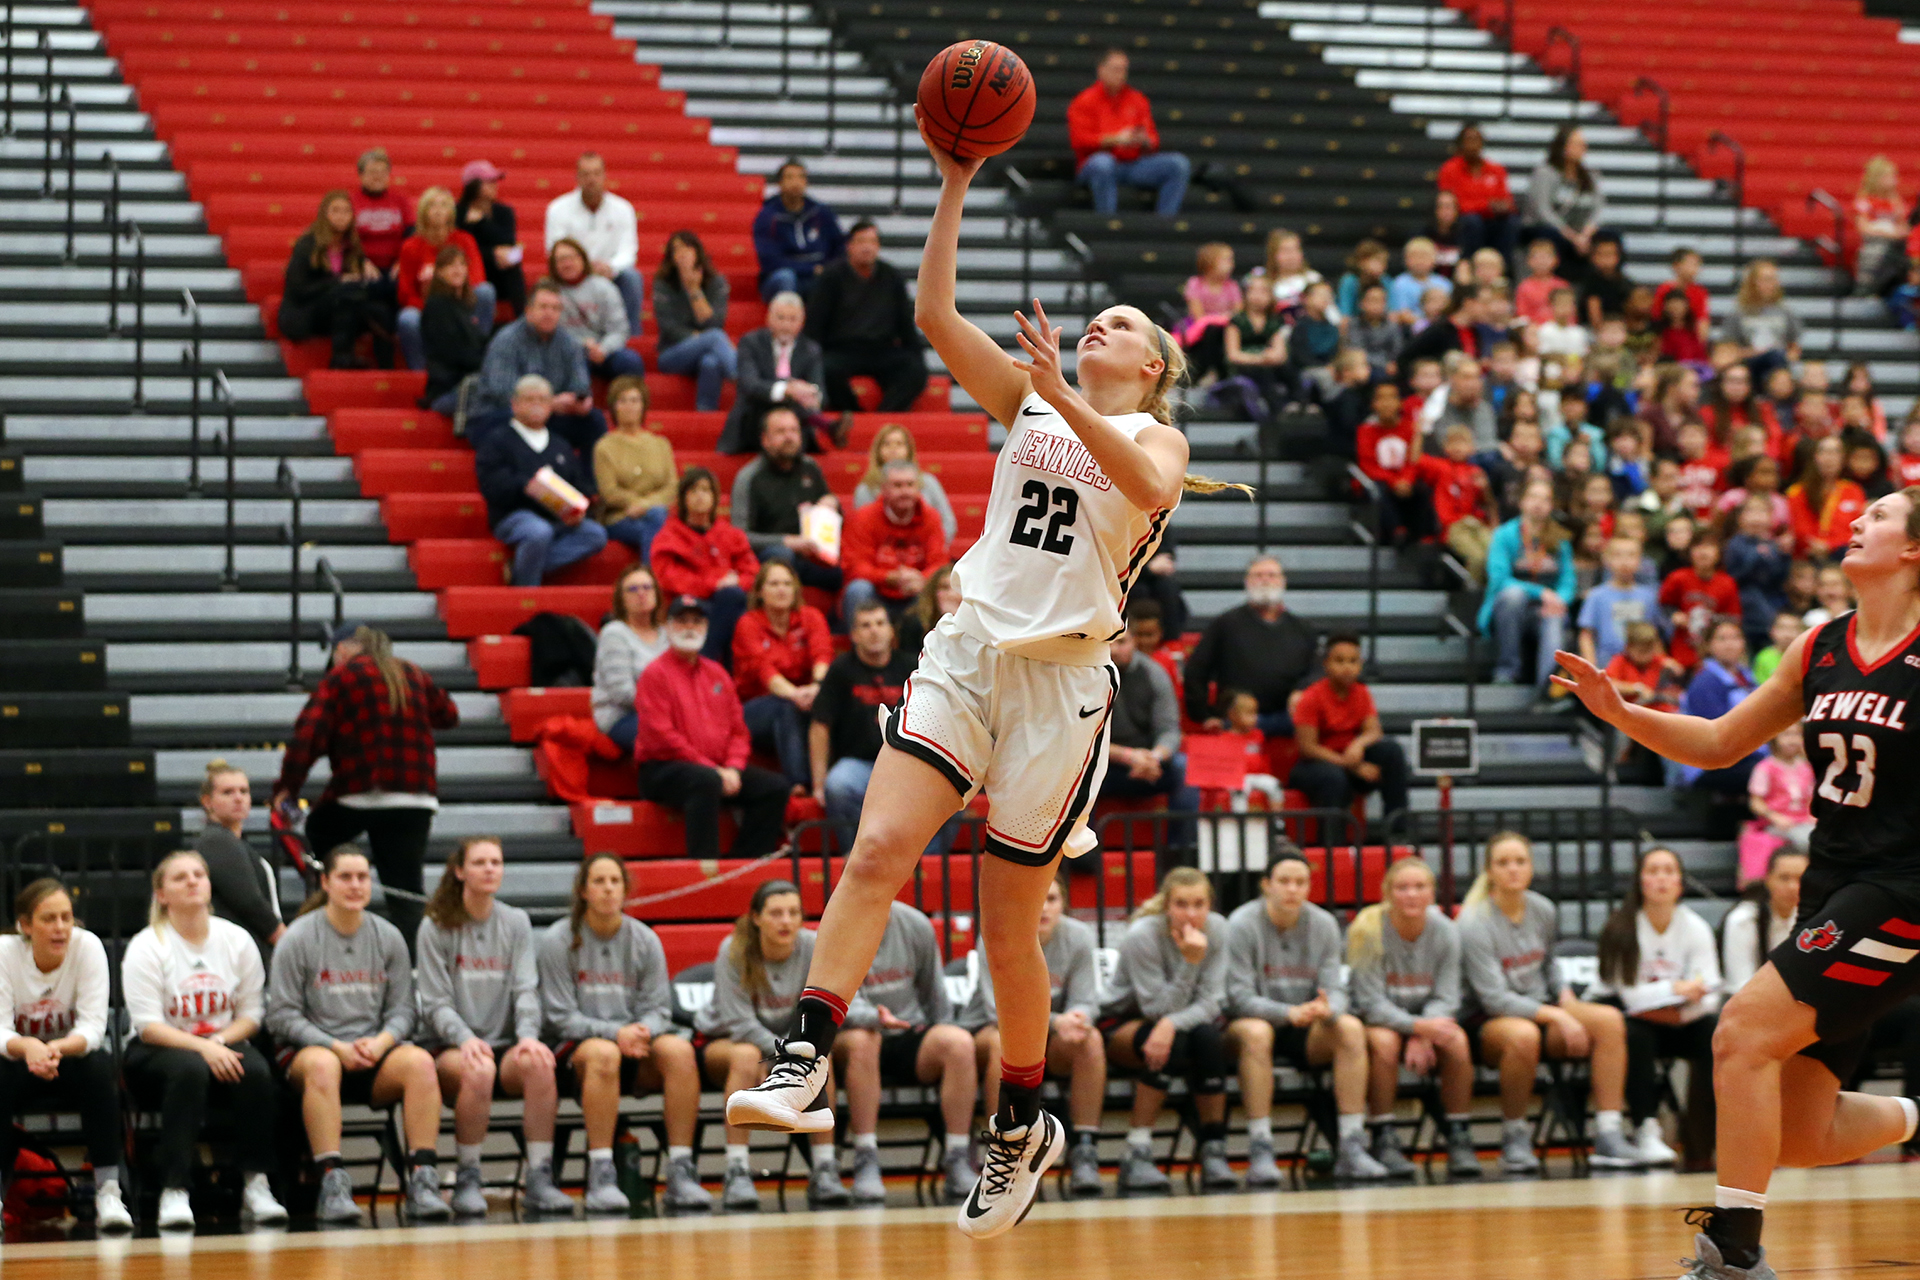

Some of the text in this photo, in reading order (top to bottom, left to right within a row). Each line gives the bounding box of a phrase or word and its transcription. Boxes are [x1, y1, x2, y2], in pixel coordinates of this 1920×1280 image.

[951, 40, 991, 89] Wils
[1009, 479, 1079, 555] 22
[1805, 690, 1907, 730] JEWELL
[1818, 732, 1876, 807] 23
